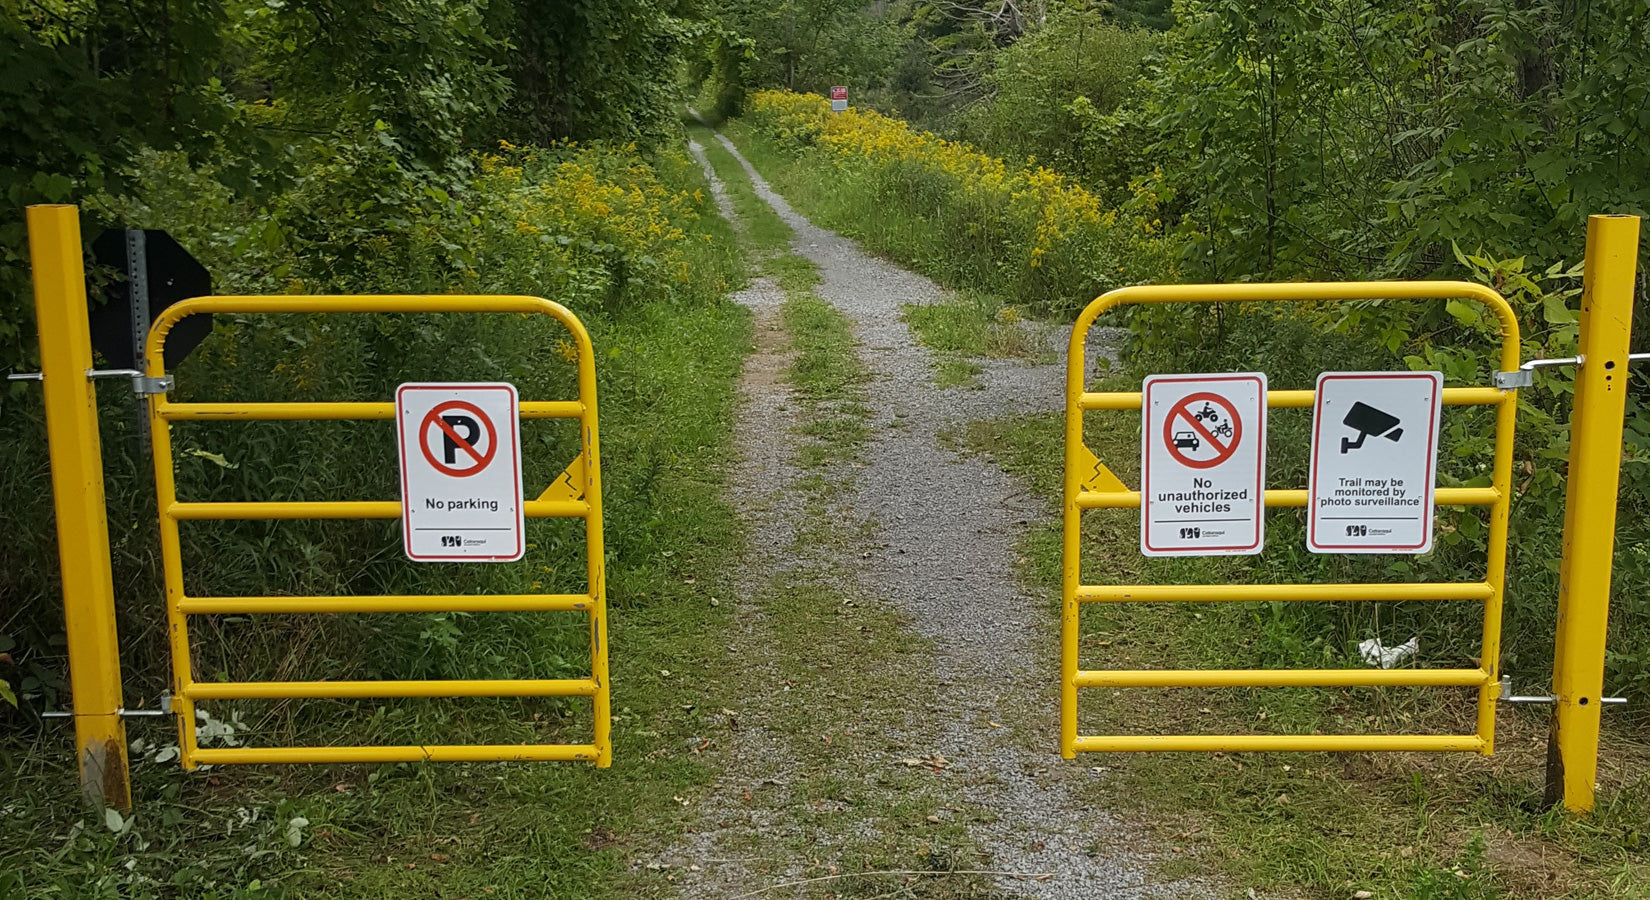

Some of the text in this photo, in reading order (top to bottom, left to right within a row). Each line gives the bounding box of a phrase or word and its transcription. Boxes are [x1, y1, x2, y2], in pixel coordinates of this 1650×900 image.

[1193, 477, 1212, 488] No
[1338, 478, 1404, 489] Trail may be
[1158, 489, 1247, 502] unauthorized
[1335, 487, 1406, 498] monitored by
[426, 498, 498, 512] No parking
[1174, 502, 1231, 514] vehicles
[1320, 497, 1420, 508] photo surveillance
